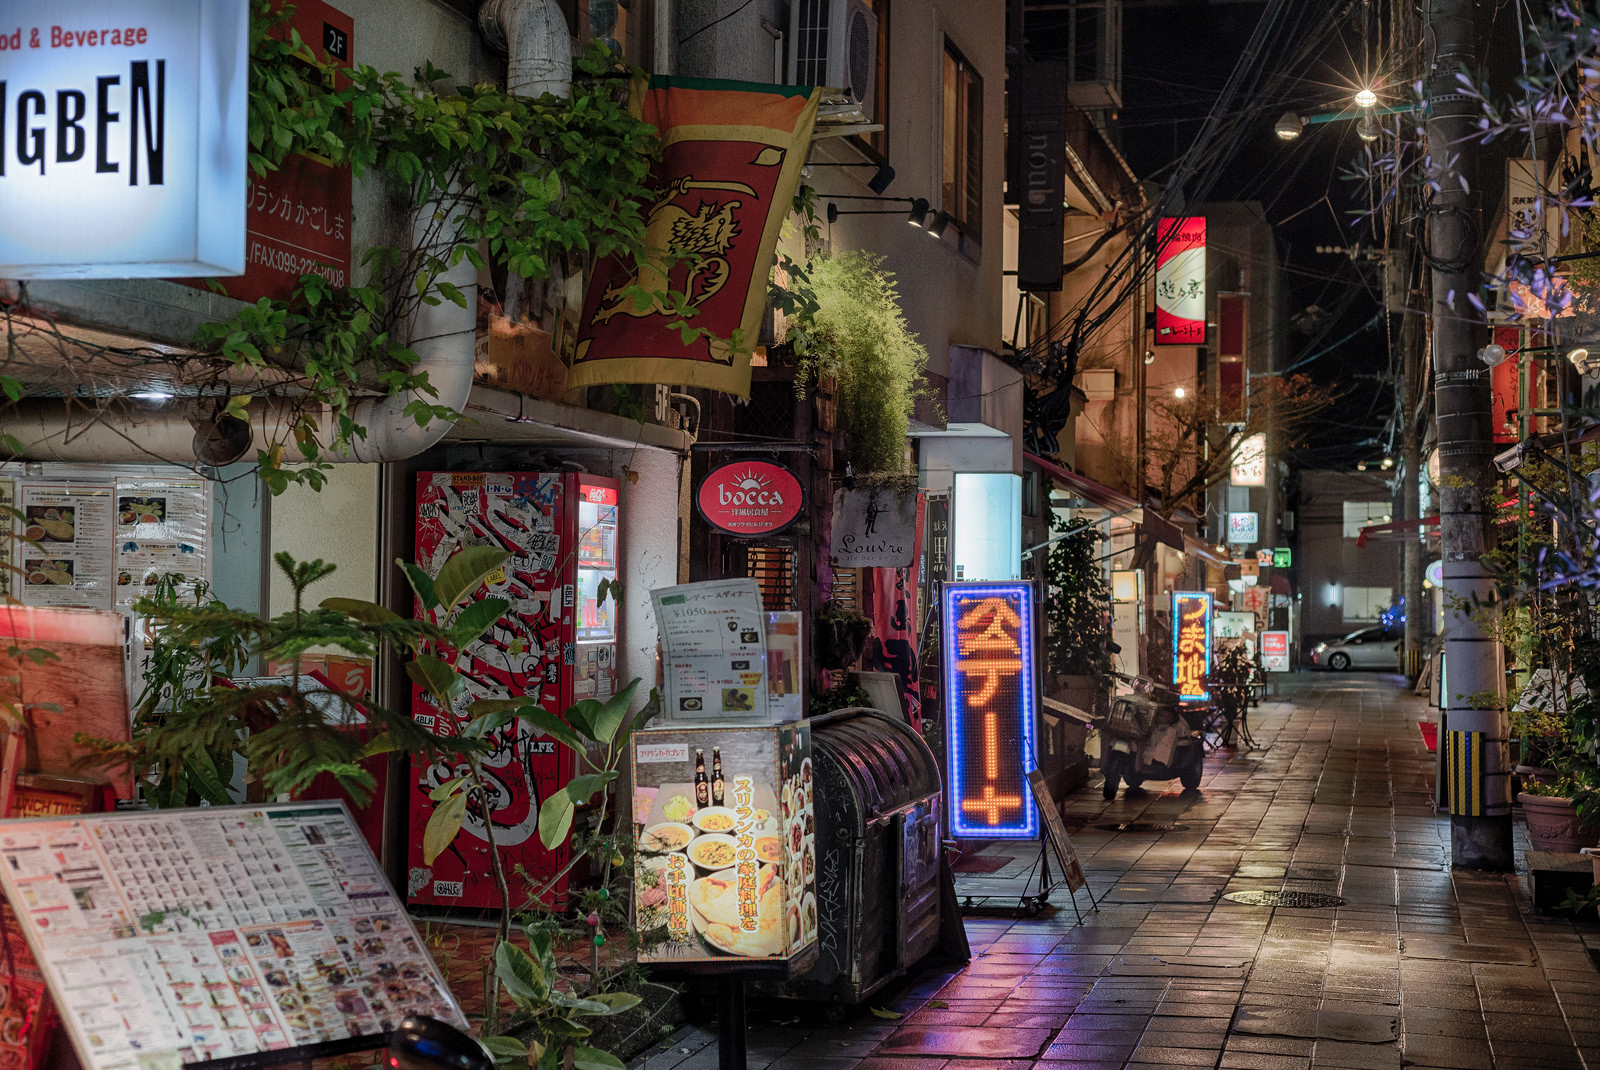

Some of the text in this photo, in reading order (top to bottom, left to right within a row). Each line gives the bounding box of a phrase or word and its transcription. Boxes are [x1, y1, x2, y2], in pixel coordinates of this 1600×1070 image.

[29, 28, 41, 48] &
[51, 25, 148, 48] Beverage
[329, 30, 343, 55] 2F
[0, 59, 166, 186] GBEN
[295, 200, 345, 241] かごしま
[718, 484, 784, 506] bocca
[838, 534, 906, 554] Louvre
[565, 585, 573, 606] 4BLK
[672, 607, 706, 618] ¥1050
[415, 715, 434, 726] 4BLK
[530, 742, 555, 753] LFK
[734, 778, 759, 931] スリランカの家庭料理を
[667, 854, 688, 943] お手頃価格で
